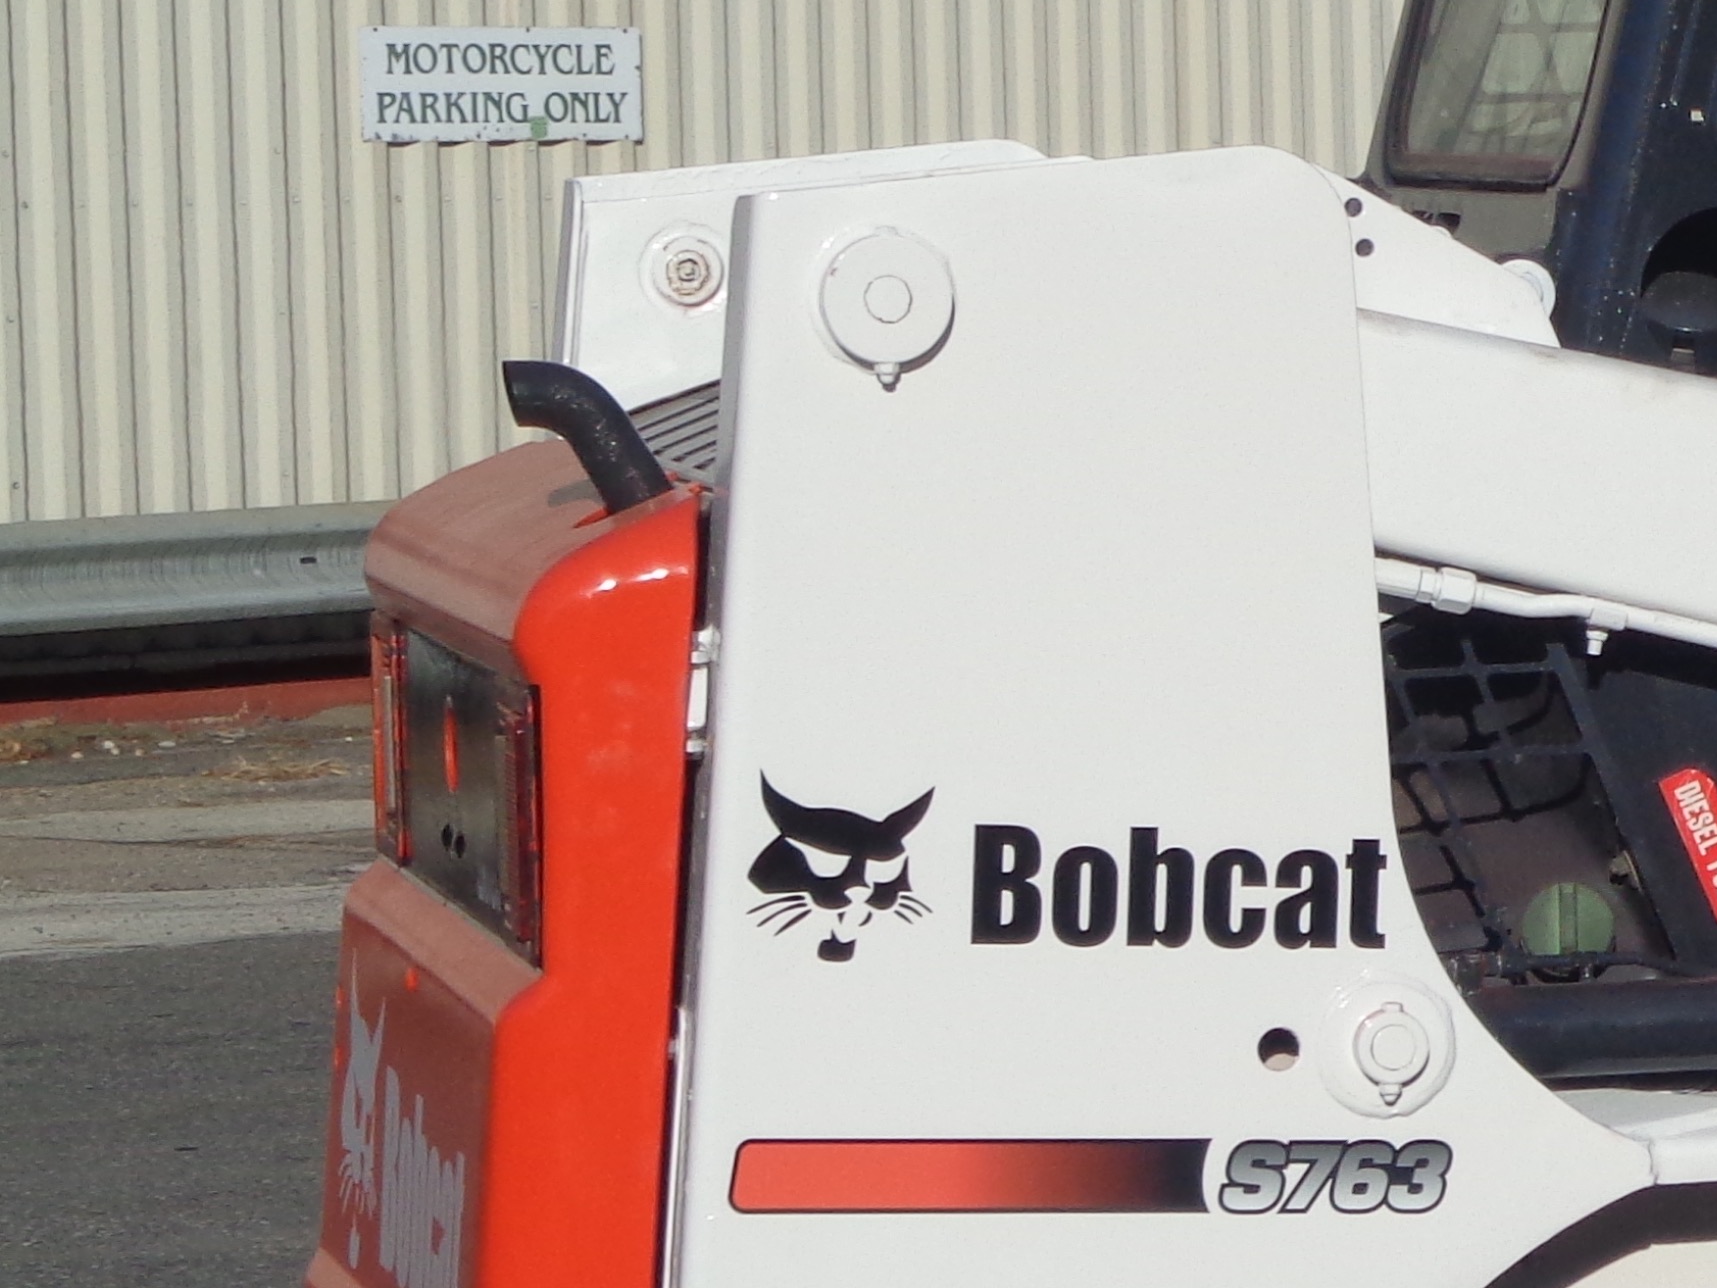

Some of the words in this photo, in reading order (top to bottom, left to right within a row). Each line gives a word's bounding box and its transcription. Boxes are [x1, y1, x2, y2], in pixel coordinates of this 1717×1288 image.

[385, 42, 615, 76] MOTORCYCLE
[376, 91, 529, 125] PARKING
[544, 91, 628, 125] ONLY
[970, 823, 1388, 951] Bobcat
[1218, 1138, 1454, 1214] S763
